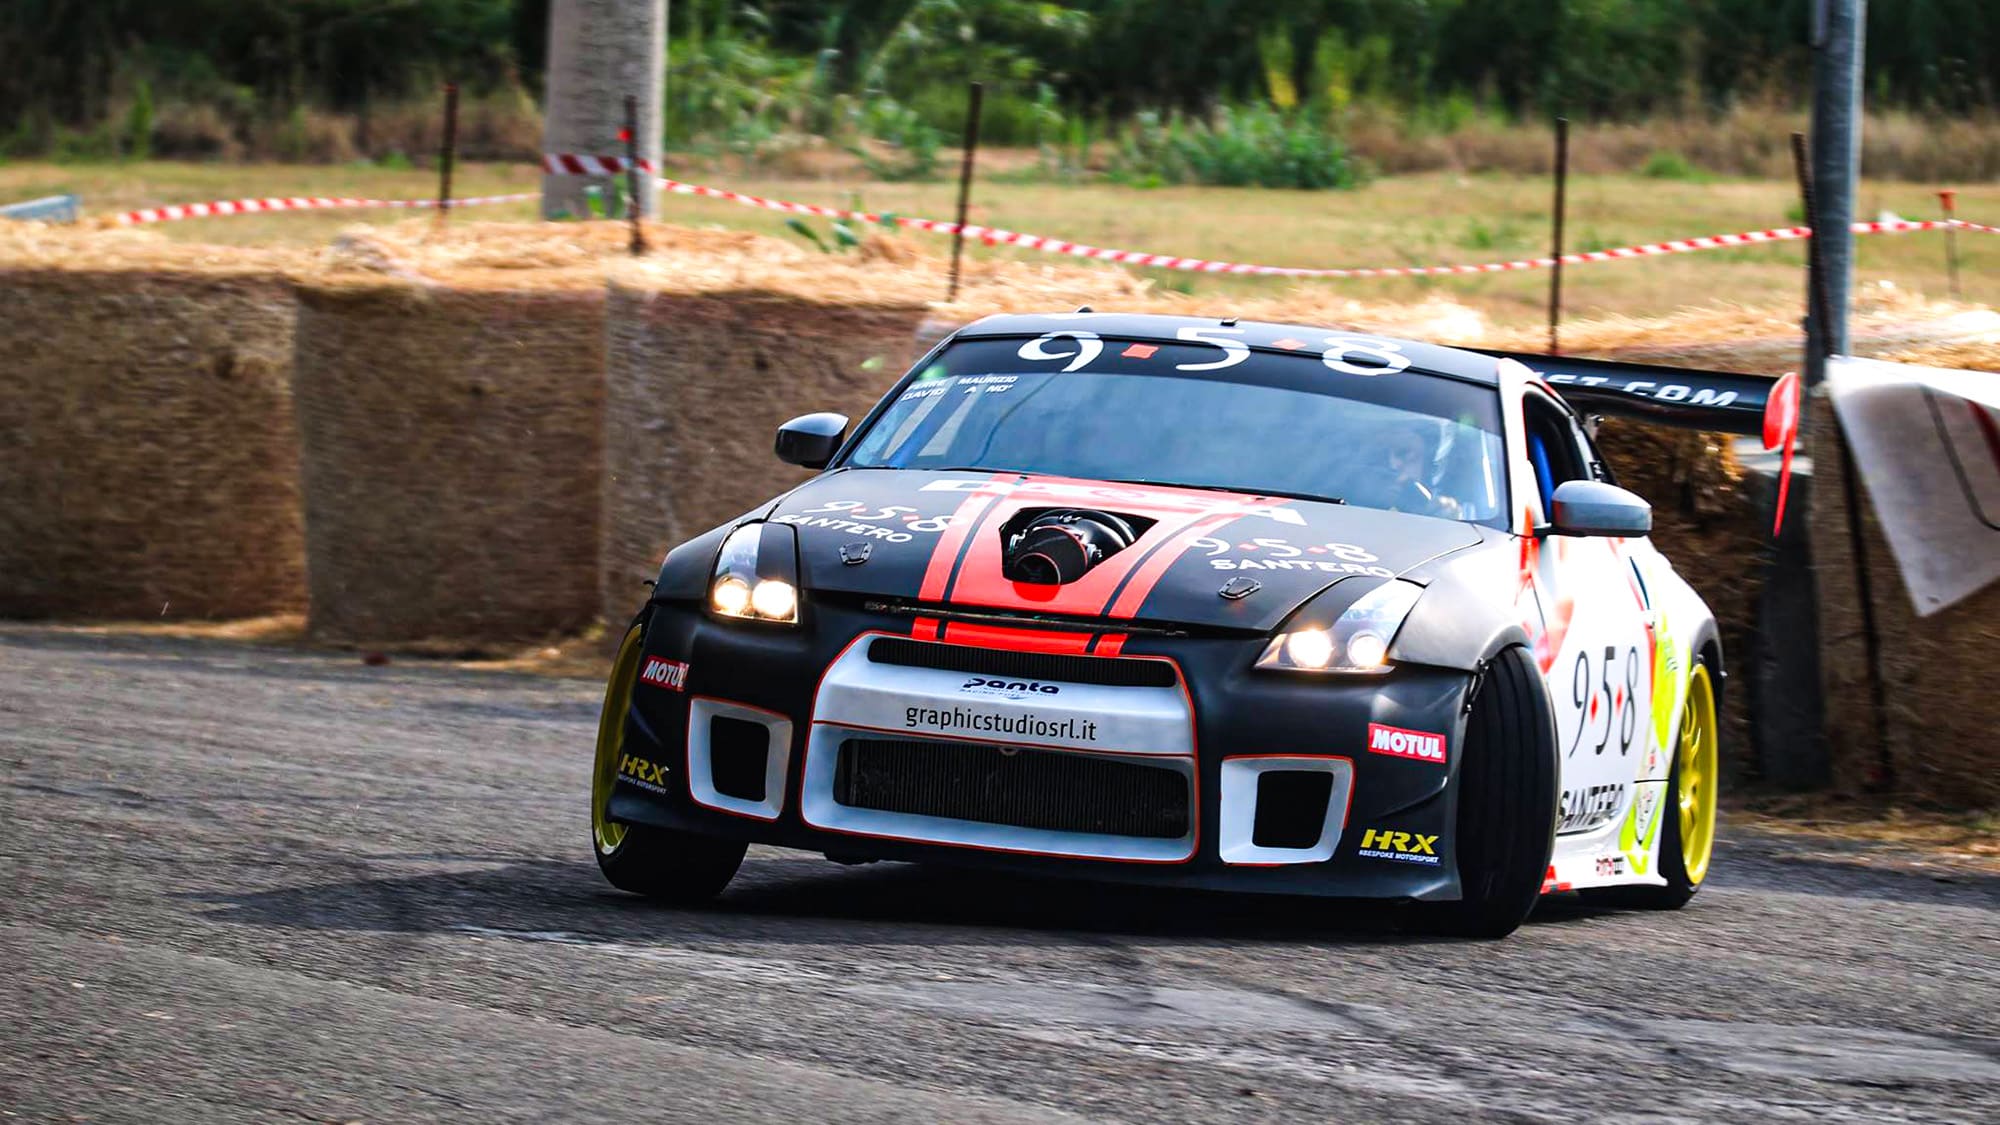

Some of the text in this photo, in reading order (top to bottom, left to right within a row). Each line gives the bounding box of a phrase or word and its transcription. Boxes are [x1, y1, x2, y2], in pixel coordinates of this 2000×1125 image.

[771, 514, 912, 543] SANTERO
[1209, 559, 1396, 578] SANTERO
[643, 659, 690, 687] MOTUL
[906, 706, 1097, 741] graphicstudiosrl.it
[1371, 728, 1442, 758] MOTUL
[620, 752, 669, 786] HRX
[1360, 828, 1440, 855] HRX
